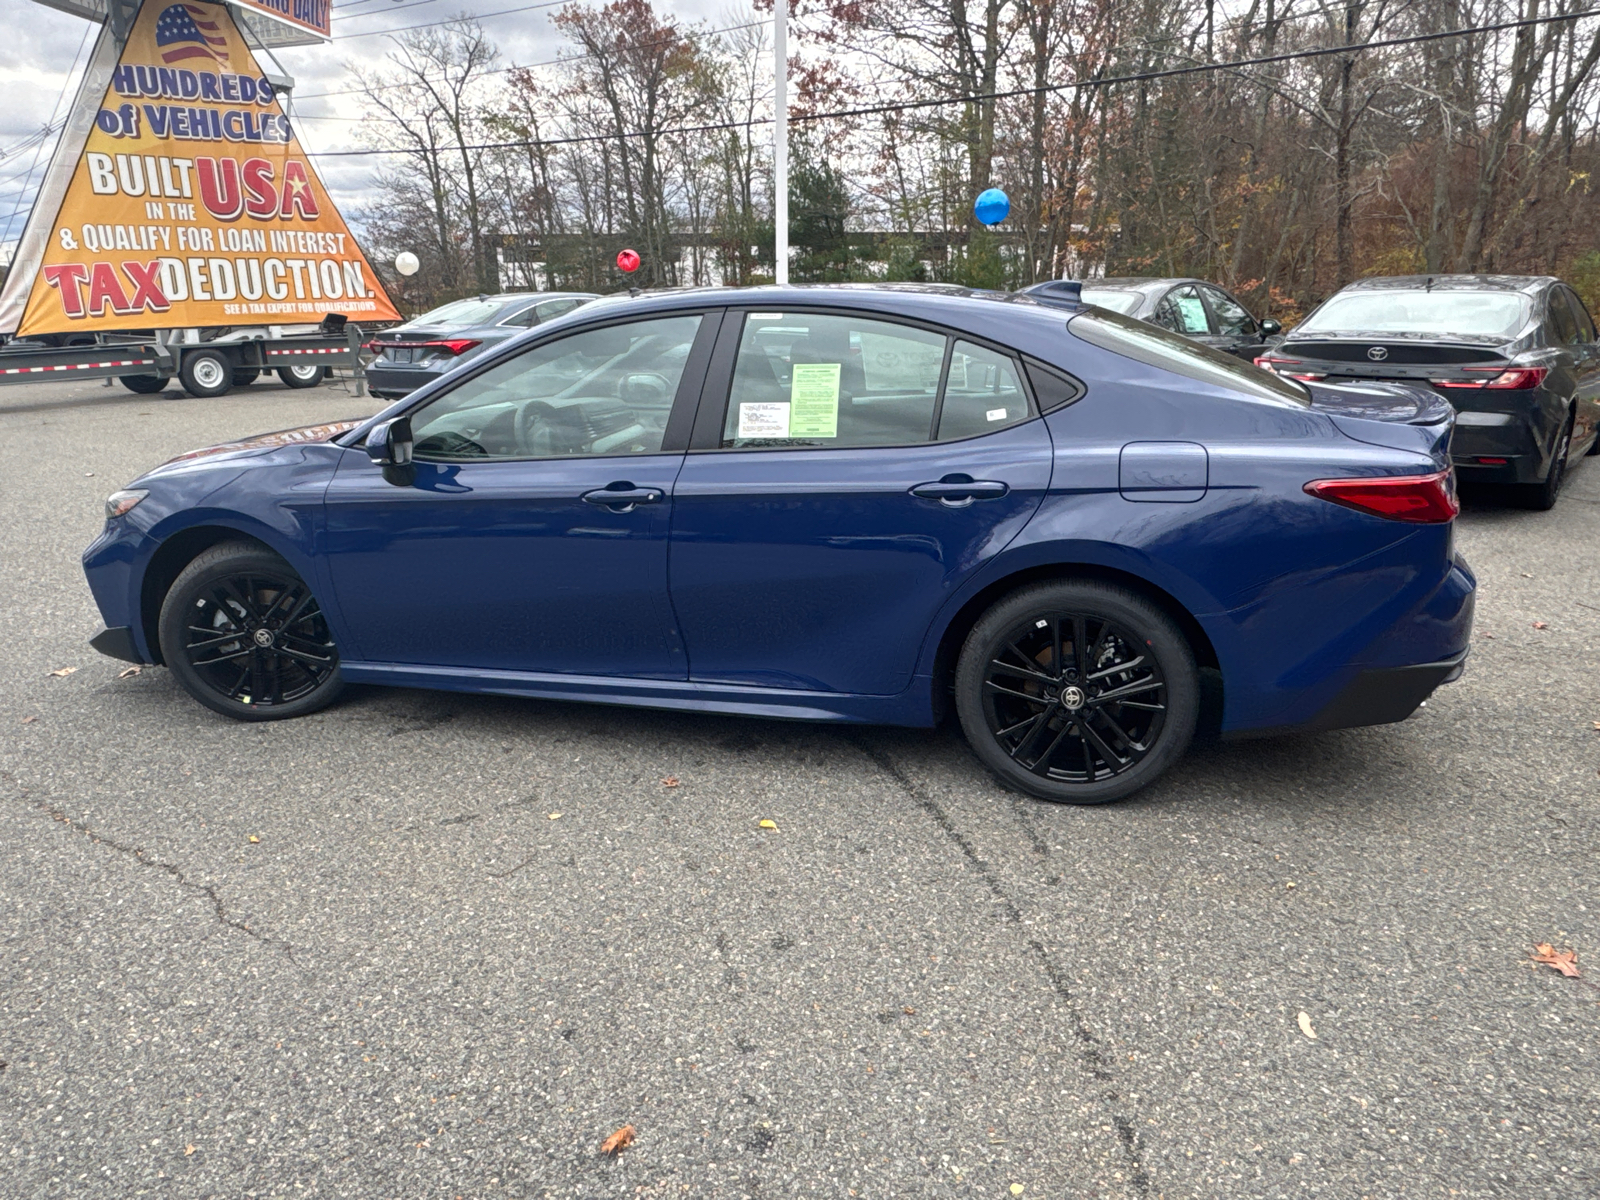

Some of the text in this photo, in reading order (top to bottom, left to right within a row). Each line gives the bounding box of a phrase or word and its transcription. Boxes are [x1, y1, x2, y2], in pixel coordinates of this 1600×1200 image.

[293, 0, 327, 30] DAILY
[114, 65, 274, 106] HUNDREDS
[97, 103, 293, 144] of VEHICLES
[86, 152, 319, 221] BUILT USA
[145, 202, 197, 221] IN THE
[60, 224, 346, 255] & QUALIFY FOR LOAN INTEREST
[43, 257, 376, 318] TAX DEDUCTION.
[223, 301, 377, 315] SEE A TAX EXPERT FOR QUALIFICATIONS
